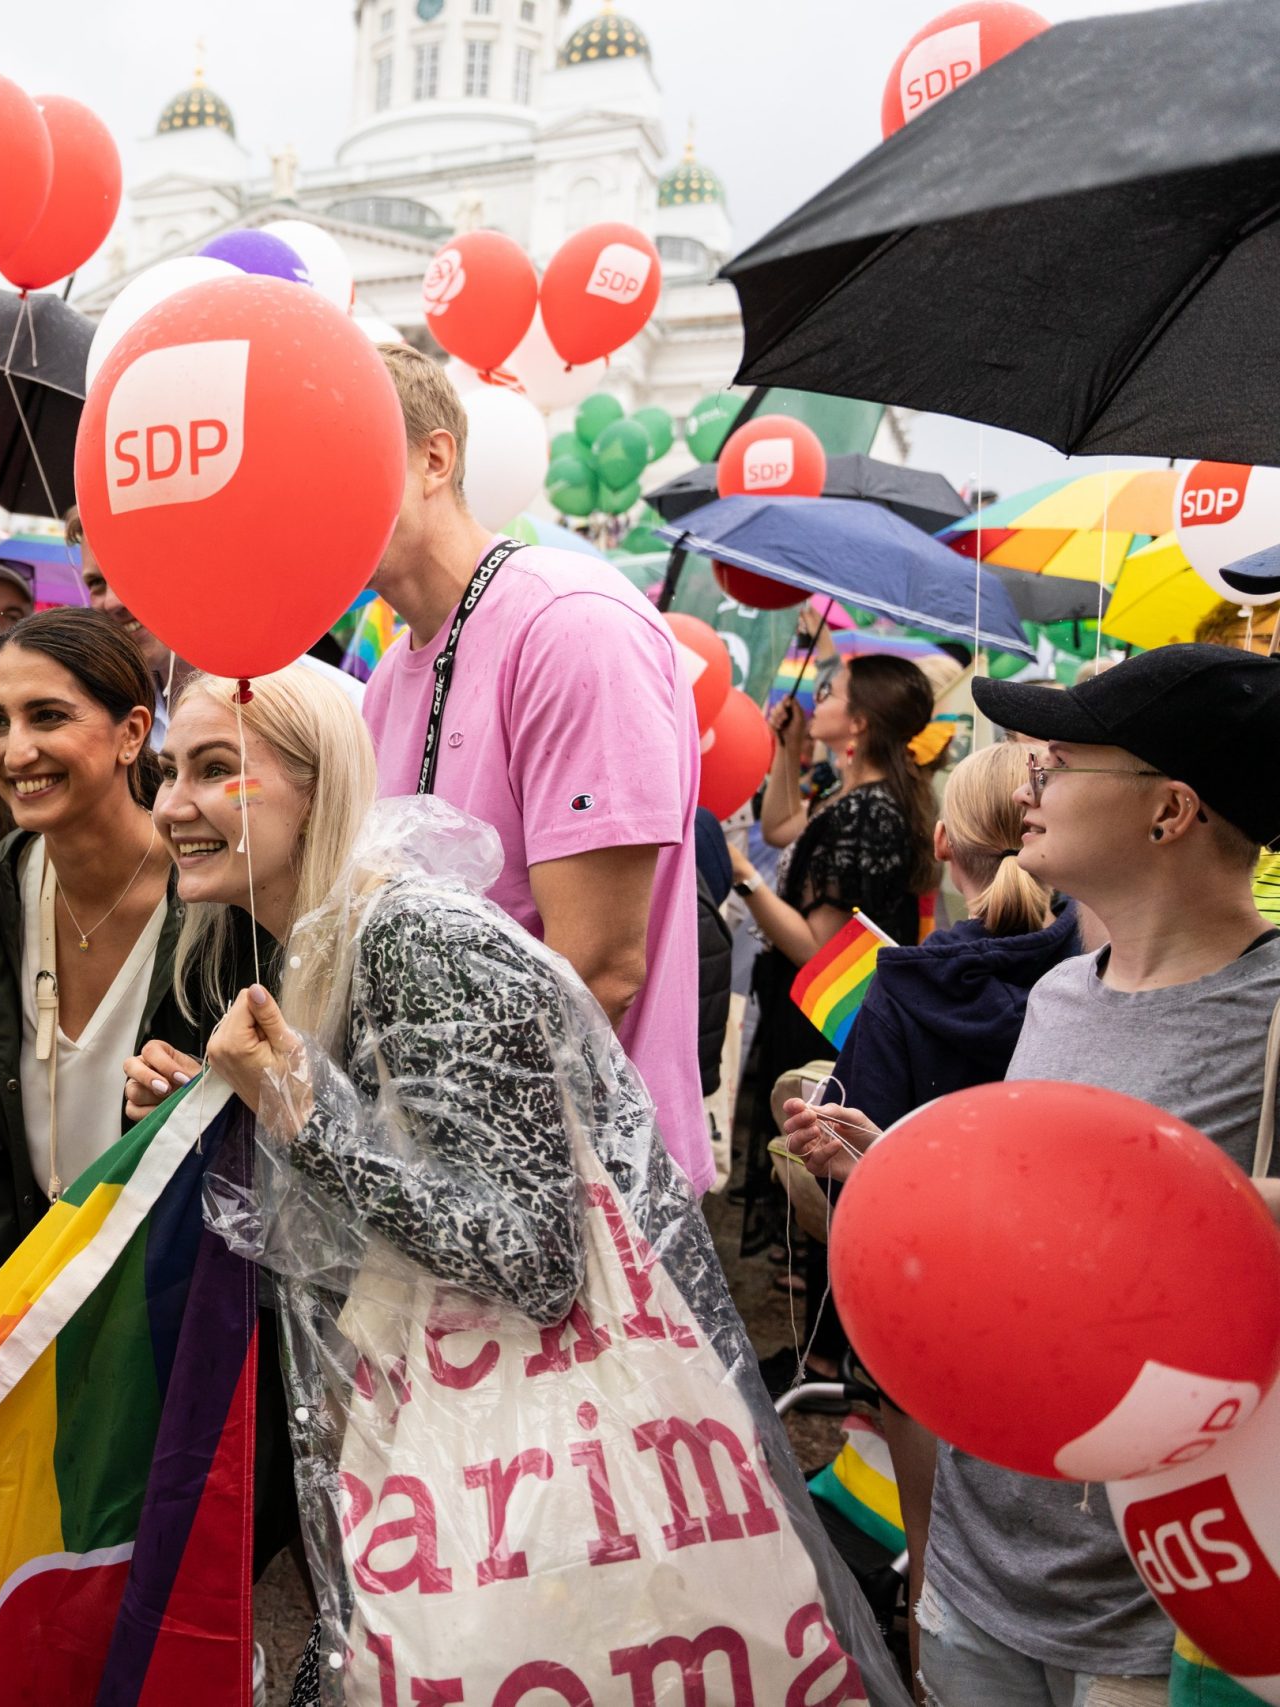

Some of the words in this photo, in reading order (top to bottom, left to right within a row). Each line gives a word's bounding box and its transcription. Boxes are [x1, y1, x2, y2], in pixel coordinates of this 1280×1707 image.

[907, 60, 972, 110] SDP
[595, 267, 639, 295] SDP
[114, 419, 228, 488] SDP
[748, 463, 788, 483] SDP
[1182, 487, 1239, 519] SDP
[465, 548, 510, 611] adidas
[417, 757, 430, 796] das
[339, 1400, 784, 1595] arim
[1137, 1507, 1253, 1595] SDP
